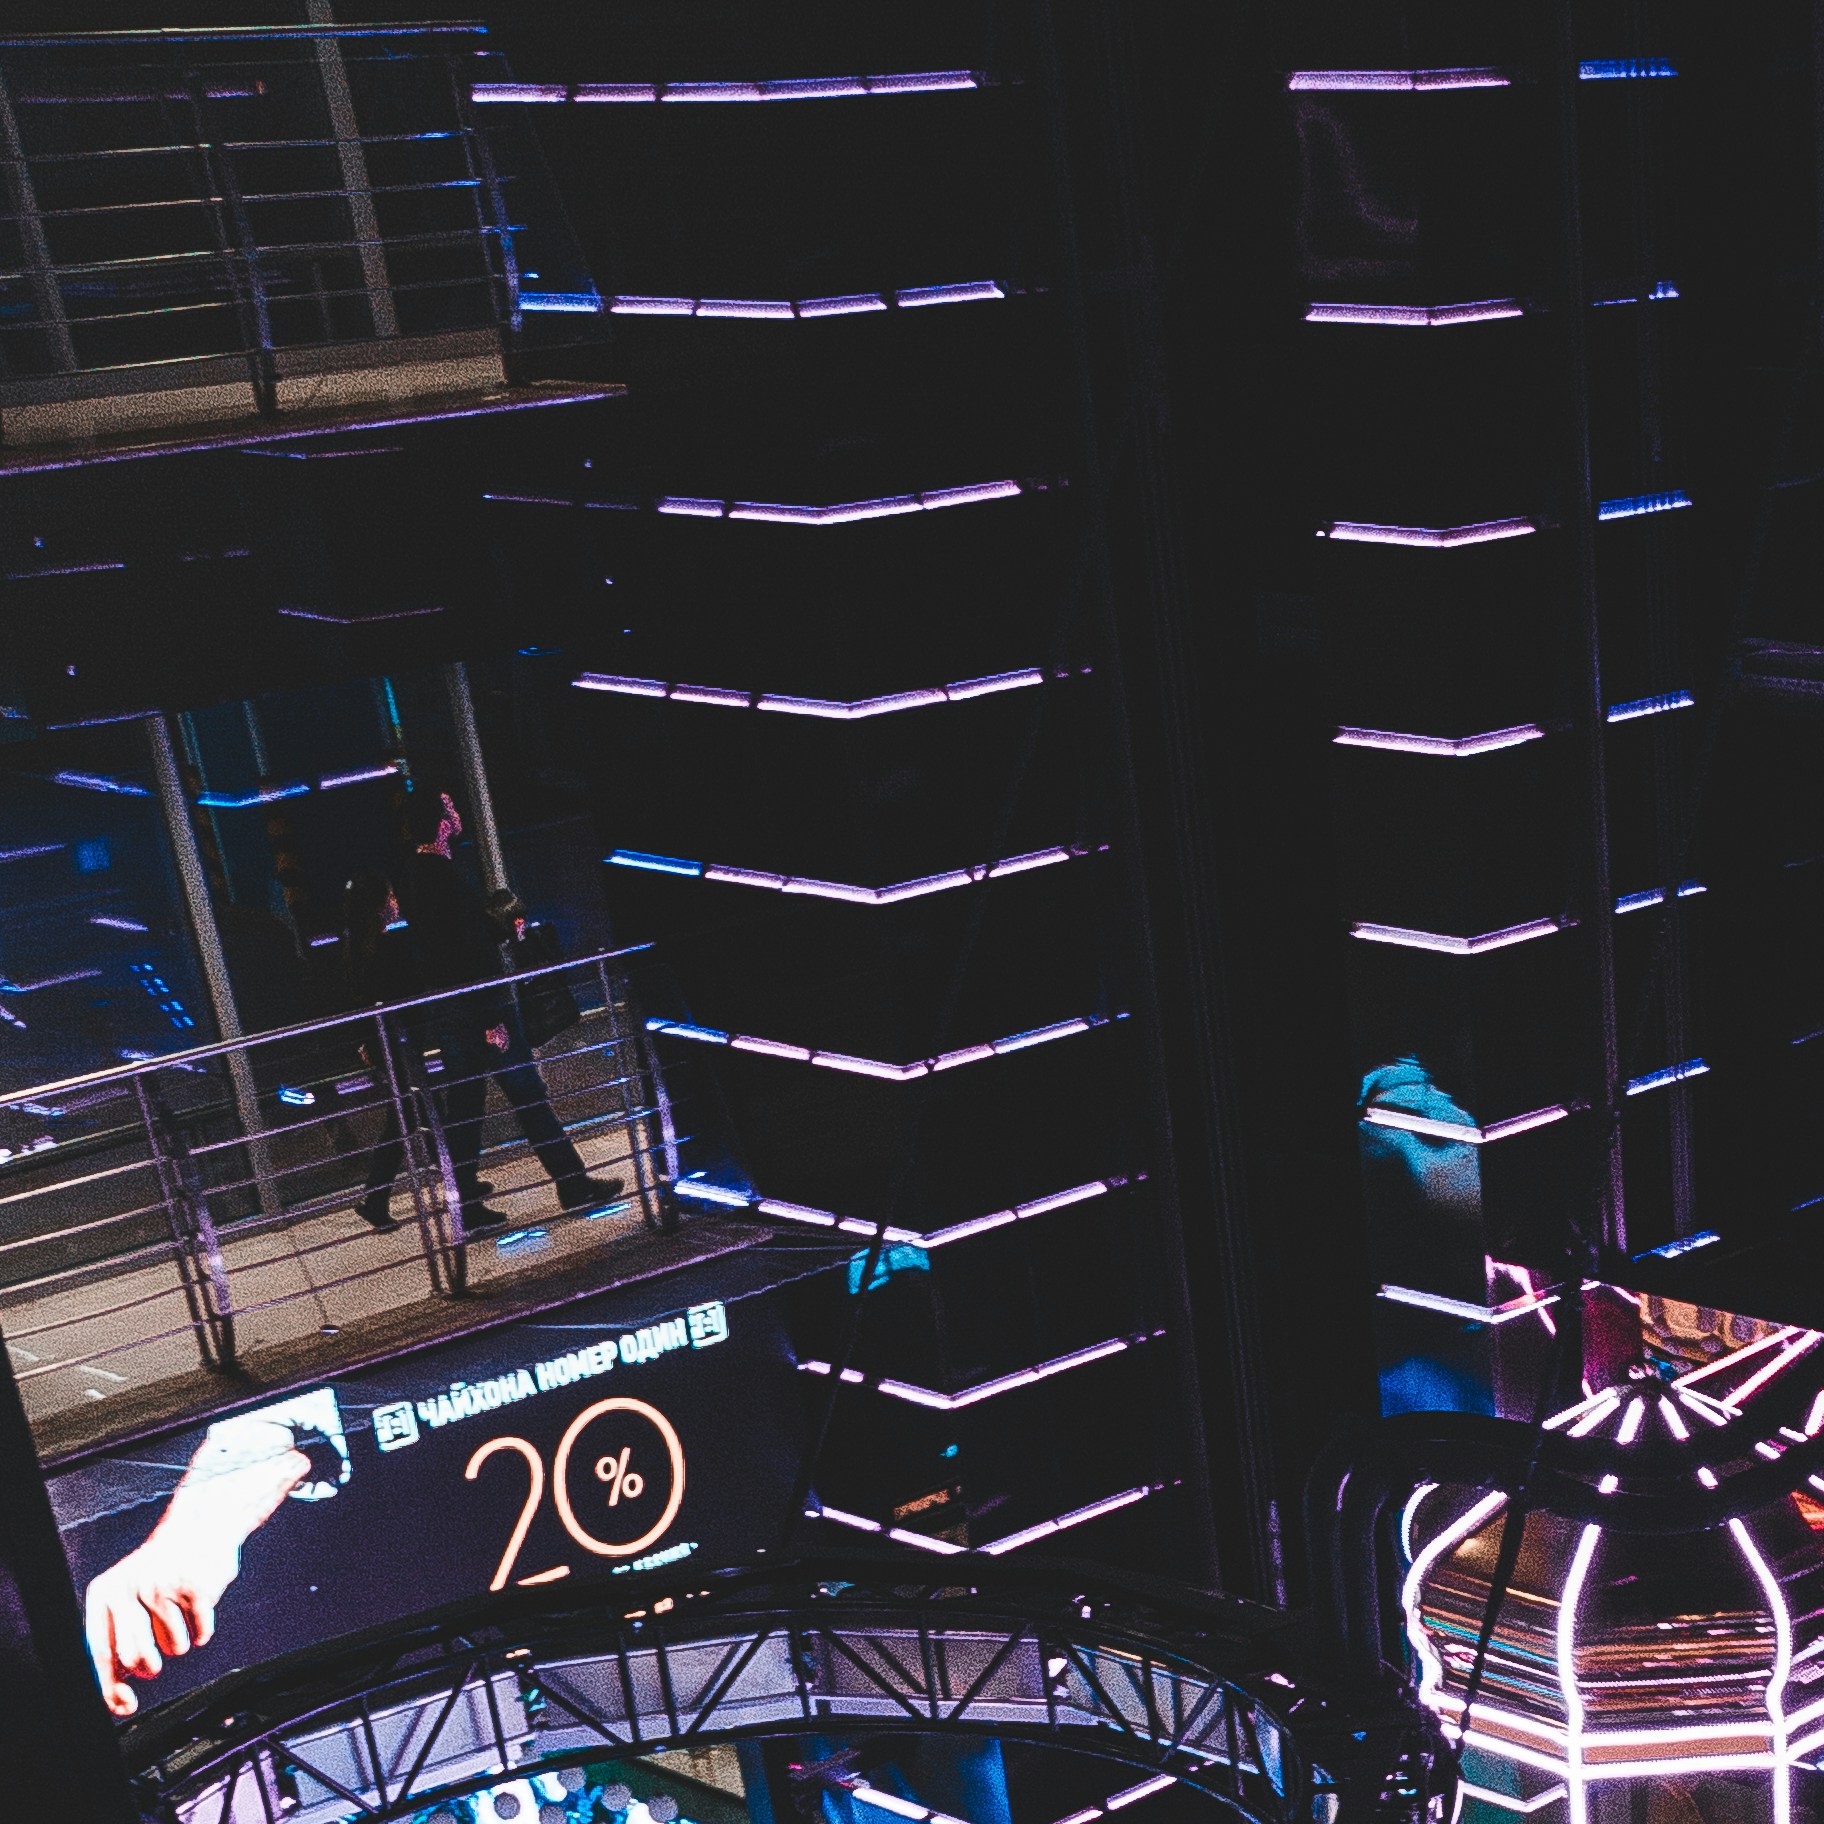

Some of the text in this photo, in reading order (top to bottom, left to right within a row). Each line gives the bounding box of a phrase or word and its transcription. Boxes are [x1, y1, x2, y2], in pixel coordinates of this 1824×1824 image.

[416, 1317, 690, 1429] ЧАЙХОНА НОМЕР ОДИН
